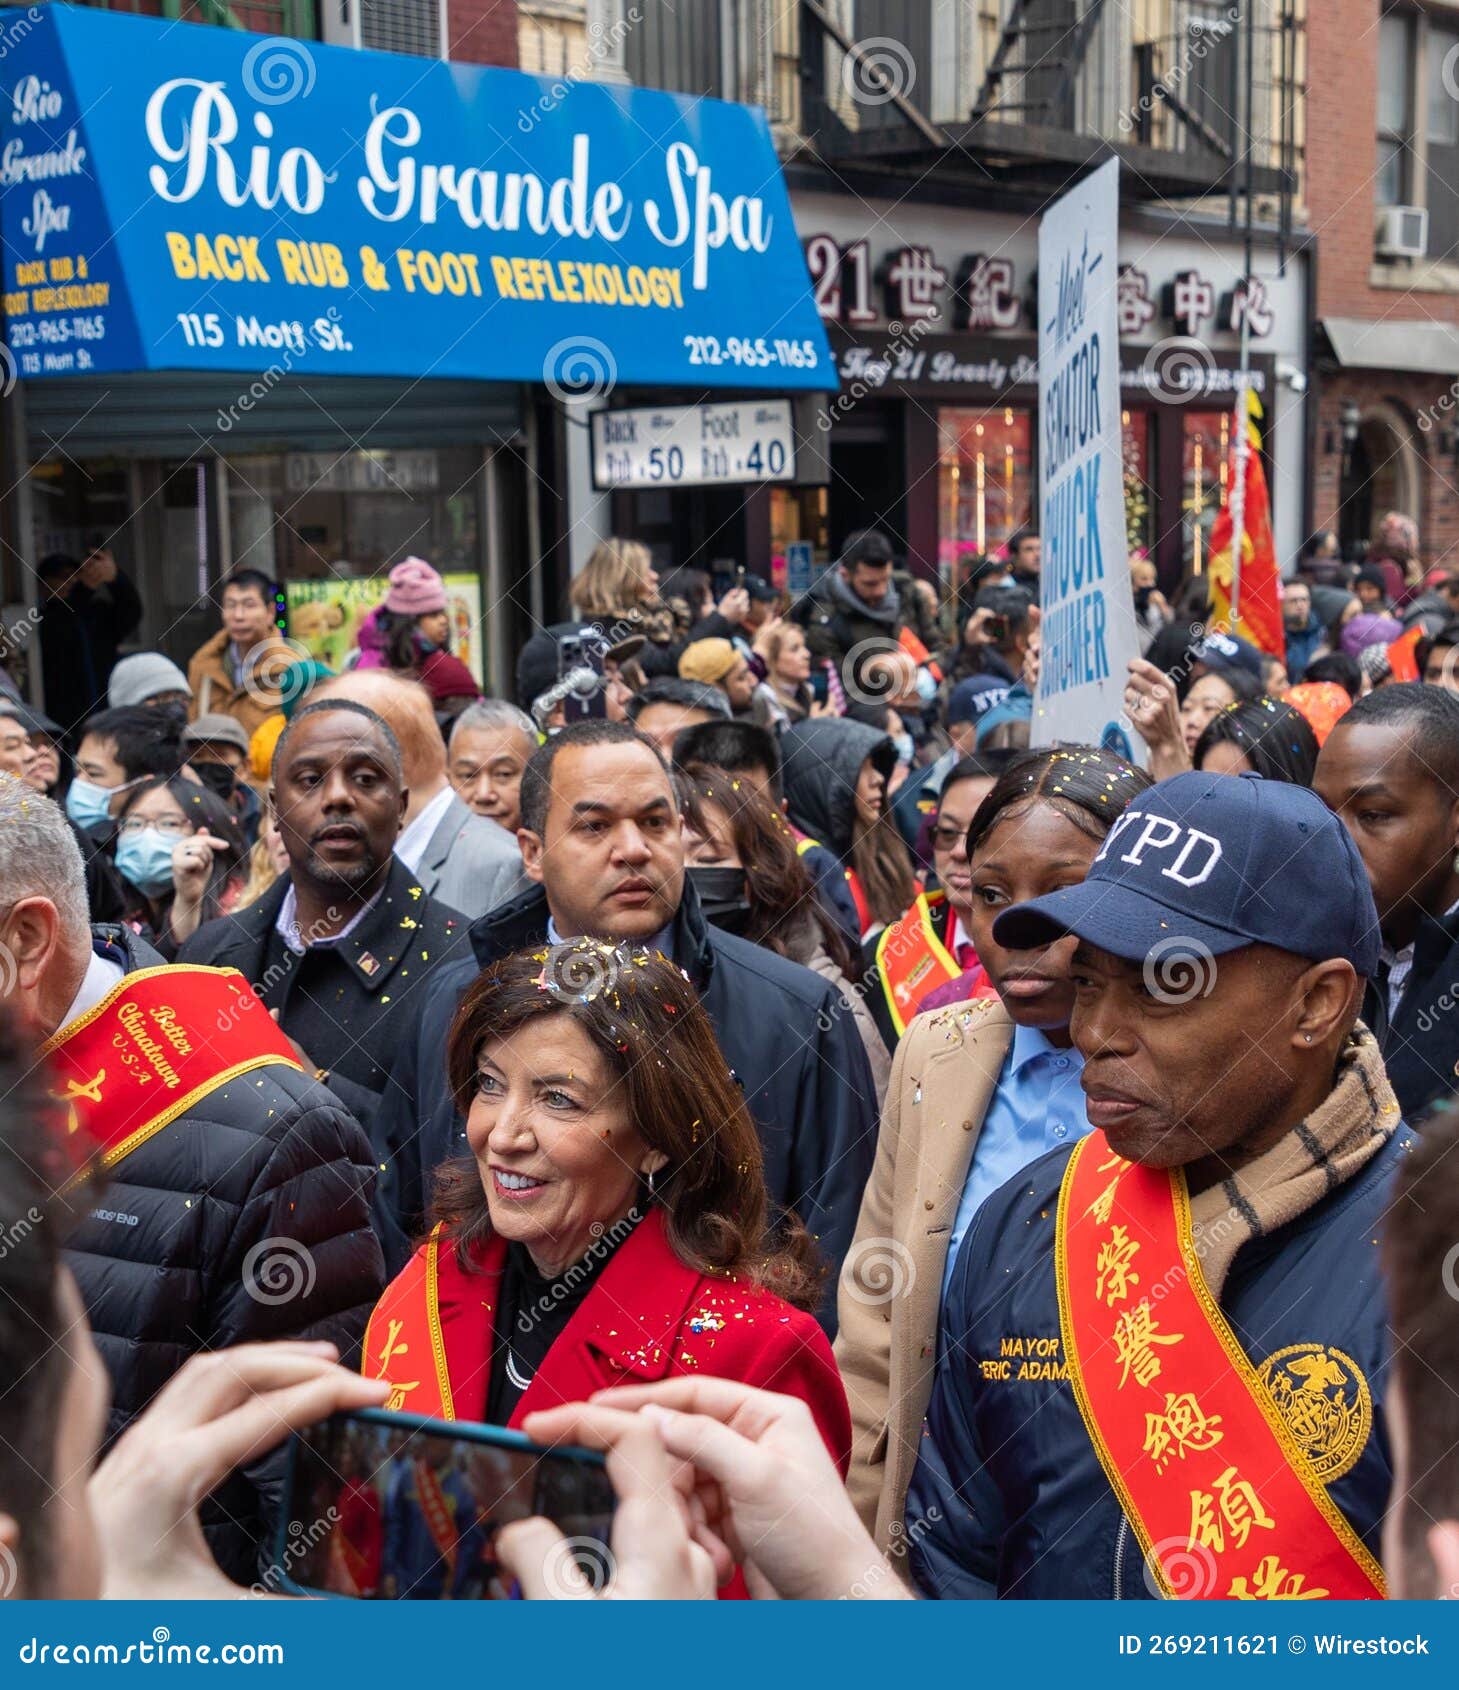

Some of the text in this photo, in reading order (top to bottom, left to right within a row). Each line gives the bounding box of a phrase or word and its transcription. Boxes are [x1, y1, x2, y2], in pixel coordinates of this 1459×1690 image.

[12, 74, 62, 125] Rio
[0, 128, 86, 186] Grande
[145, 77, 773, 290] Rio Grande Spa
[22, 188, 71, 252] Spa
[16, 260, 46, 286] BACK
[51, 257, 73, 280] RUB
[165, 231, 684, 308] BACK RUB & FOOT REFLEXOLOGY
[32, 282, 110, 312] REFLEXOLOGY
[9, 315, 105, 347] 212-965-1165
[177, 313, 354, 352] 115 Mott St.
[683, 335, 818, 369] 212-965-1165
[1095, 811, 1223, 888] YPD
[117, 1001, 181, 1088] Chinatown
[149, 1004, 193, 1056] Better
[116, 1212, 139, 1226] END
[982, 1361, 1011, 1379] ERIC
[1000, 1338, 1059, 1357] MAYOR
